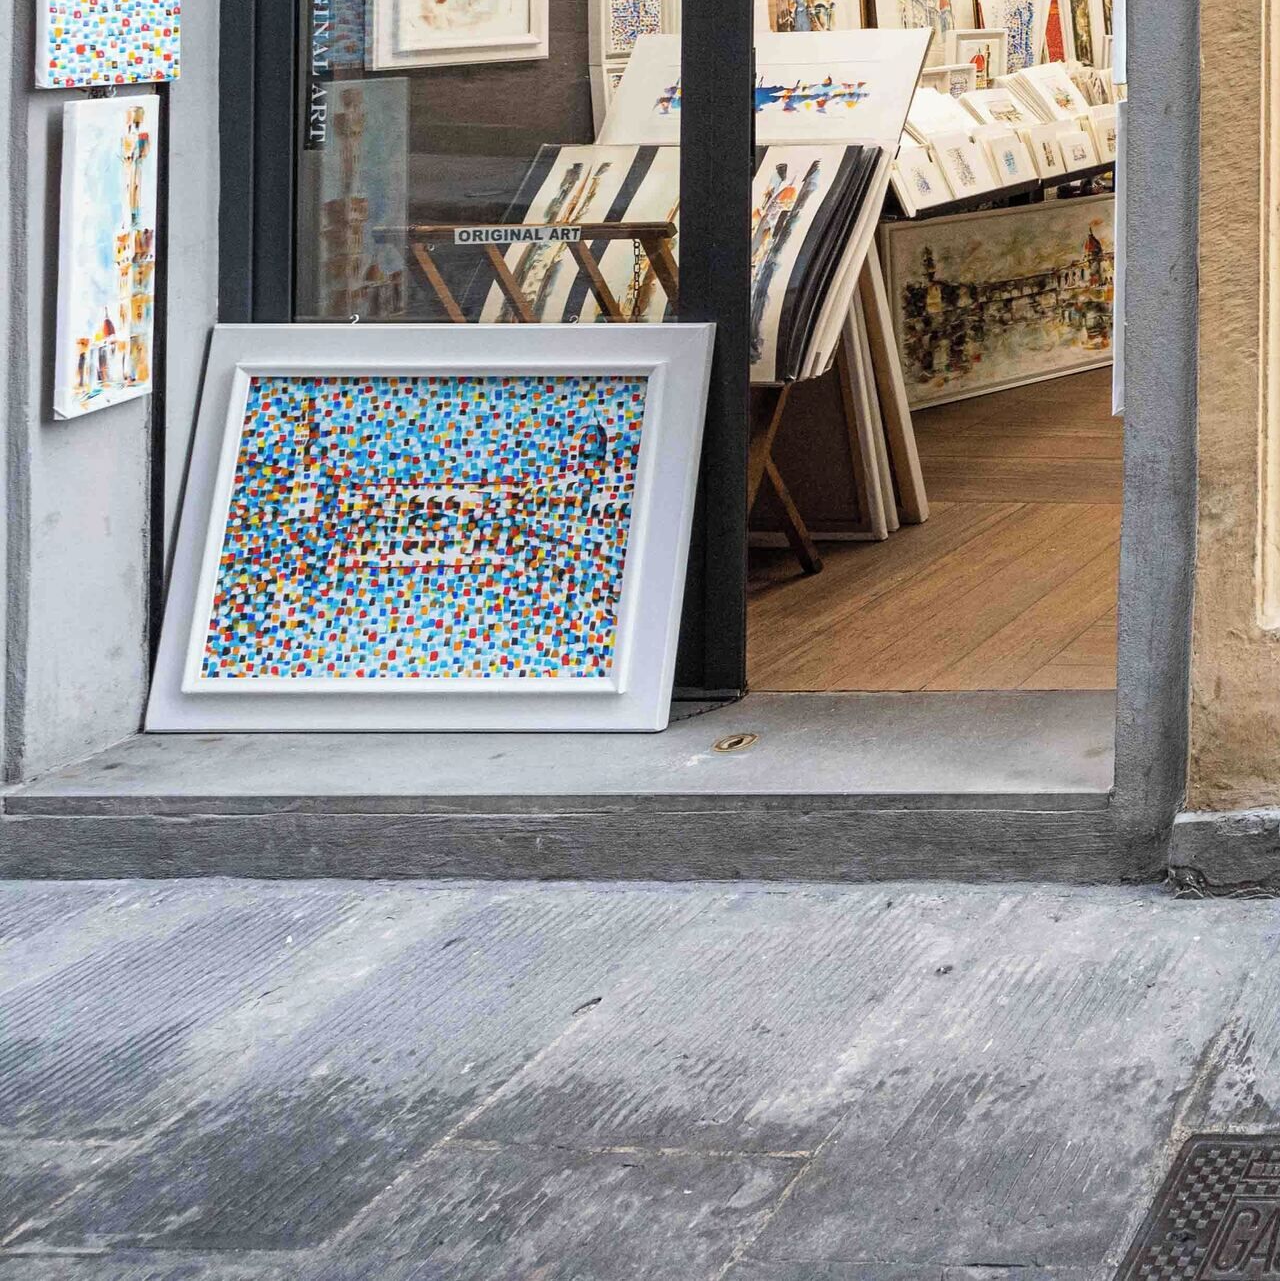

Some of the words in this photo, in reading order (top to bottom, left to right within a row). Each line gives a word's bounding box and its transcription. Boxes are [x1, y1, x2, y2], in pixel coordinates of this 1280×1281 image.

[309, 84, 328, 143] ART
[458, 228, 544, 242] ORIGINAL
[549, 227, 580, 240] ART
